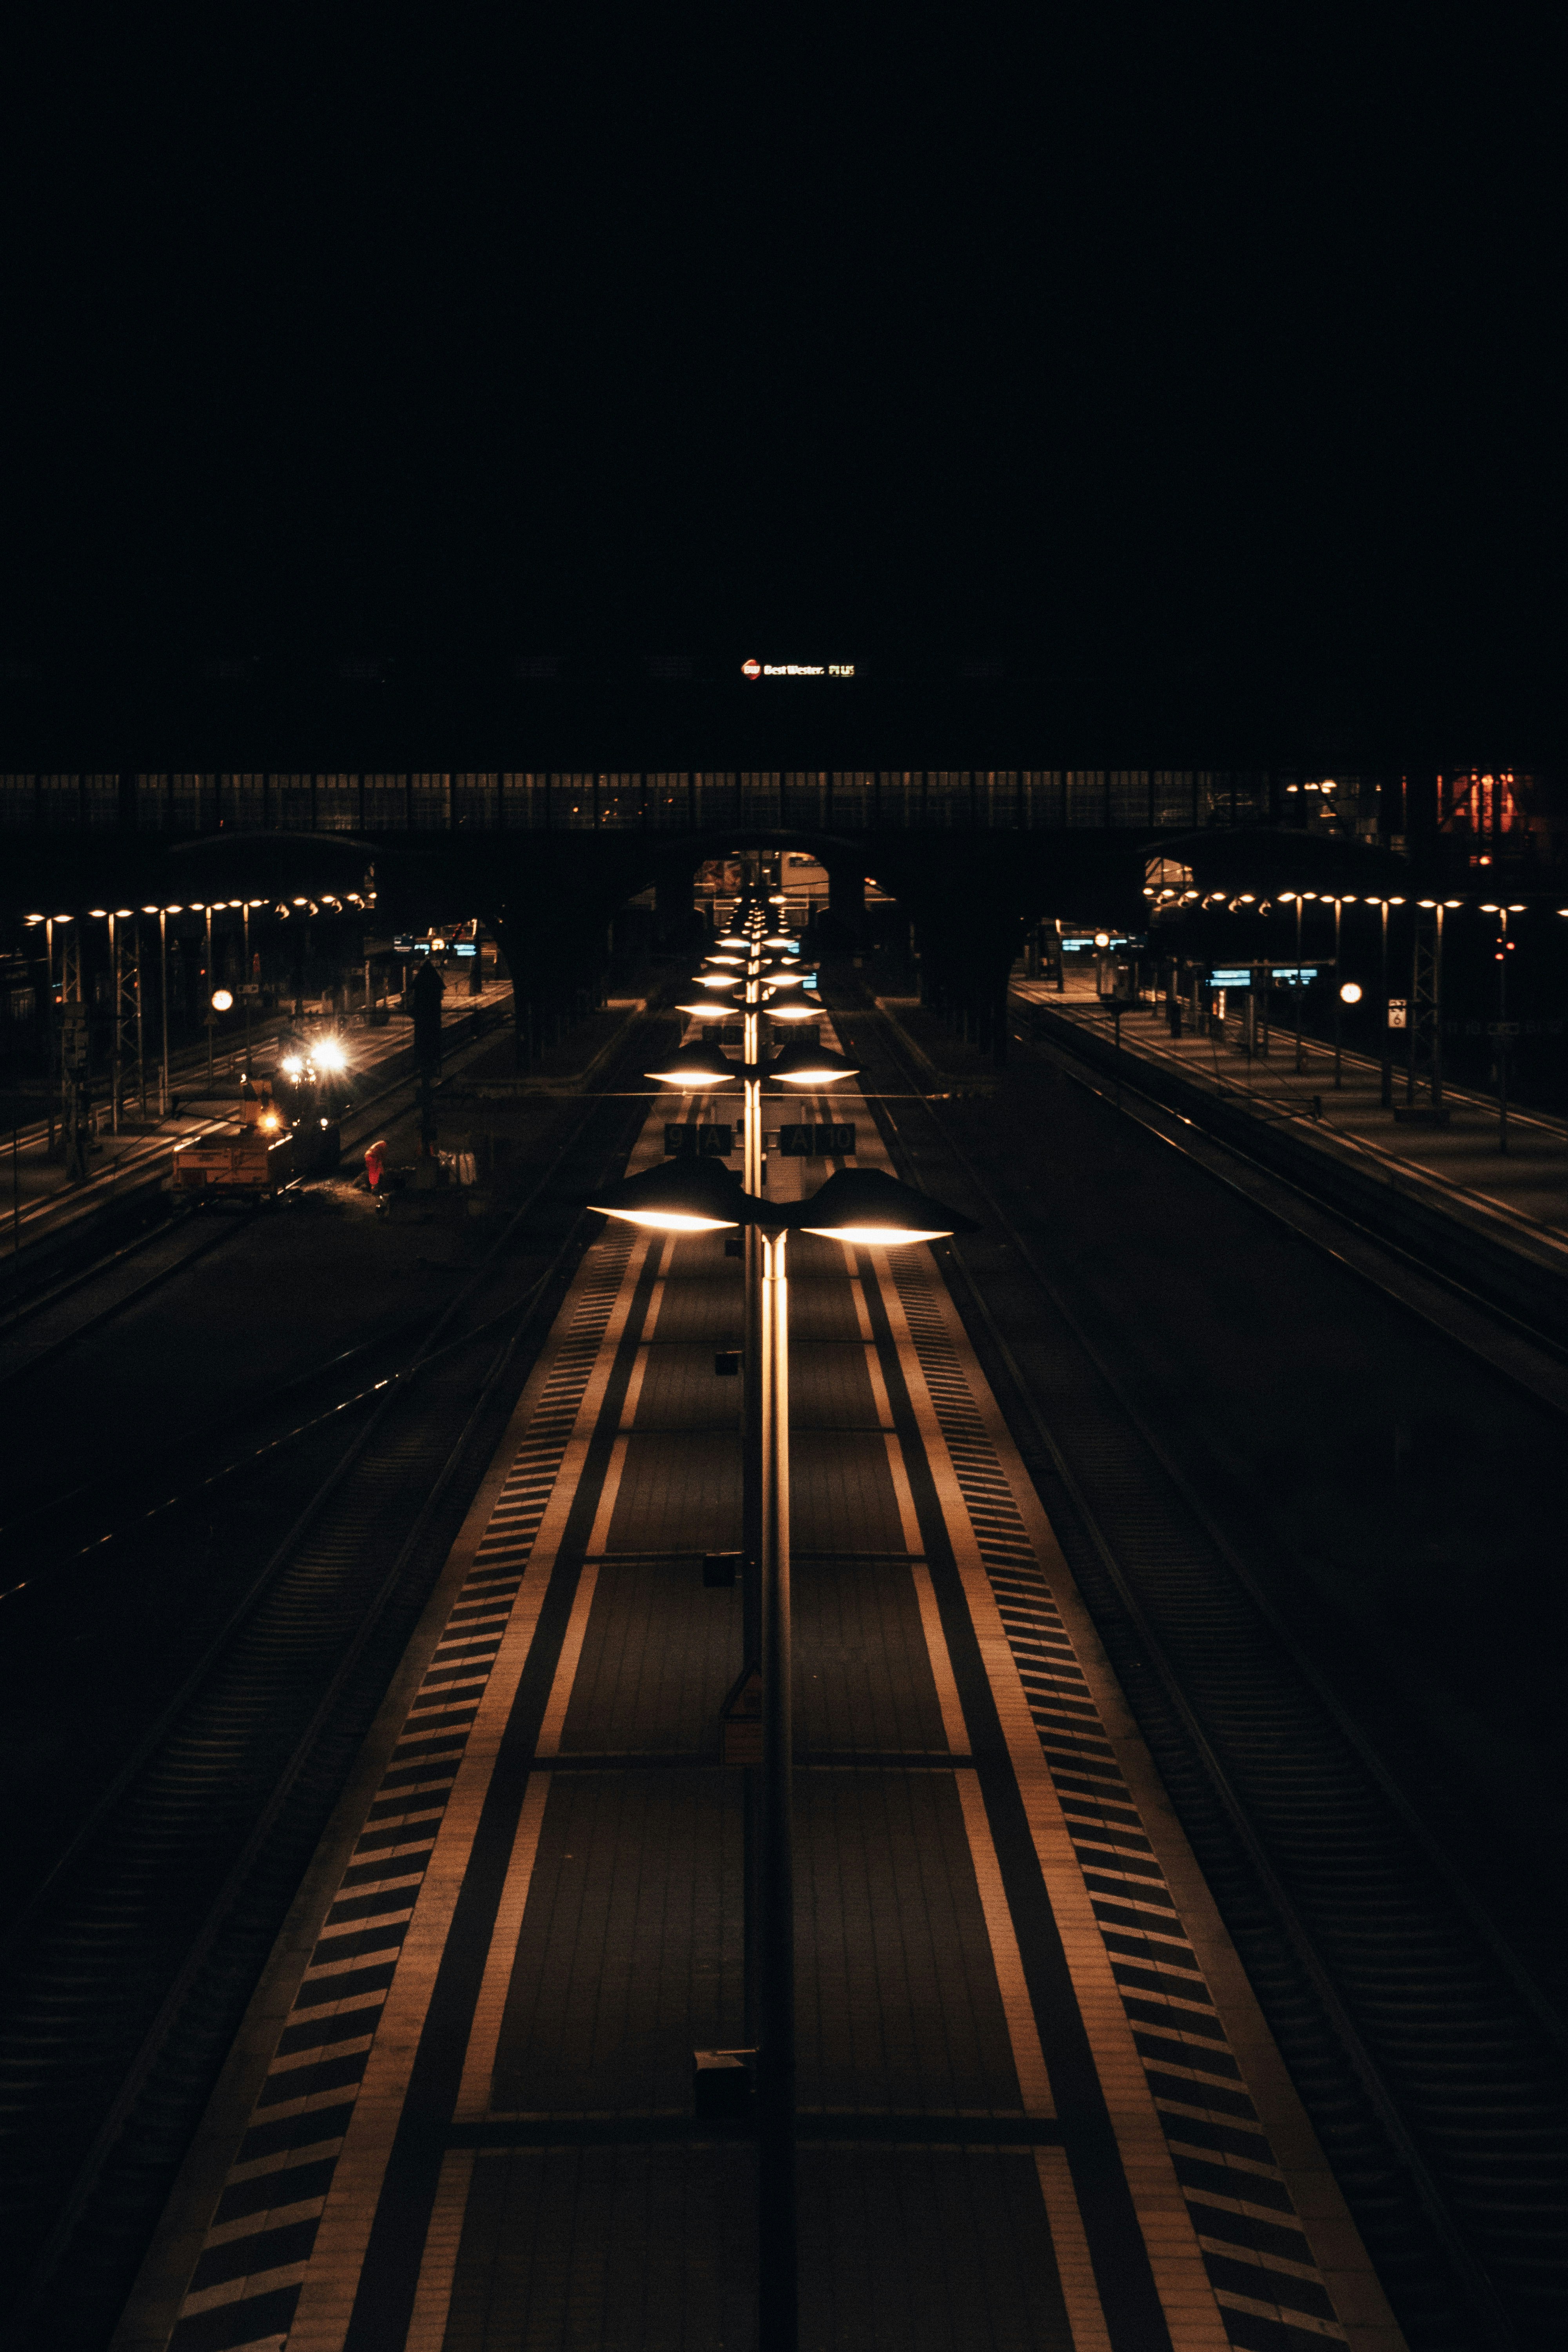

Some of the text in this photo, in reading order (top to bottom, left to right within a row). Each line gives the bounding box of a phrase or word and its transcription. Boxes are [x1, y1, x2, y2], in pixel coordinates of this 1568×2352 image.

[787, 665, 824, 675] Wester
[705, 1127, 721, 1149] A
[791, 1127, 809, 1150] A
